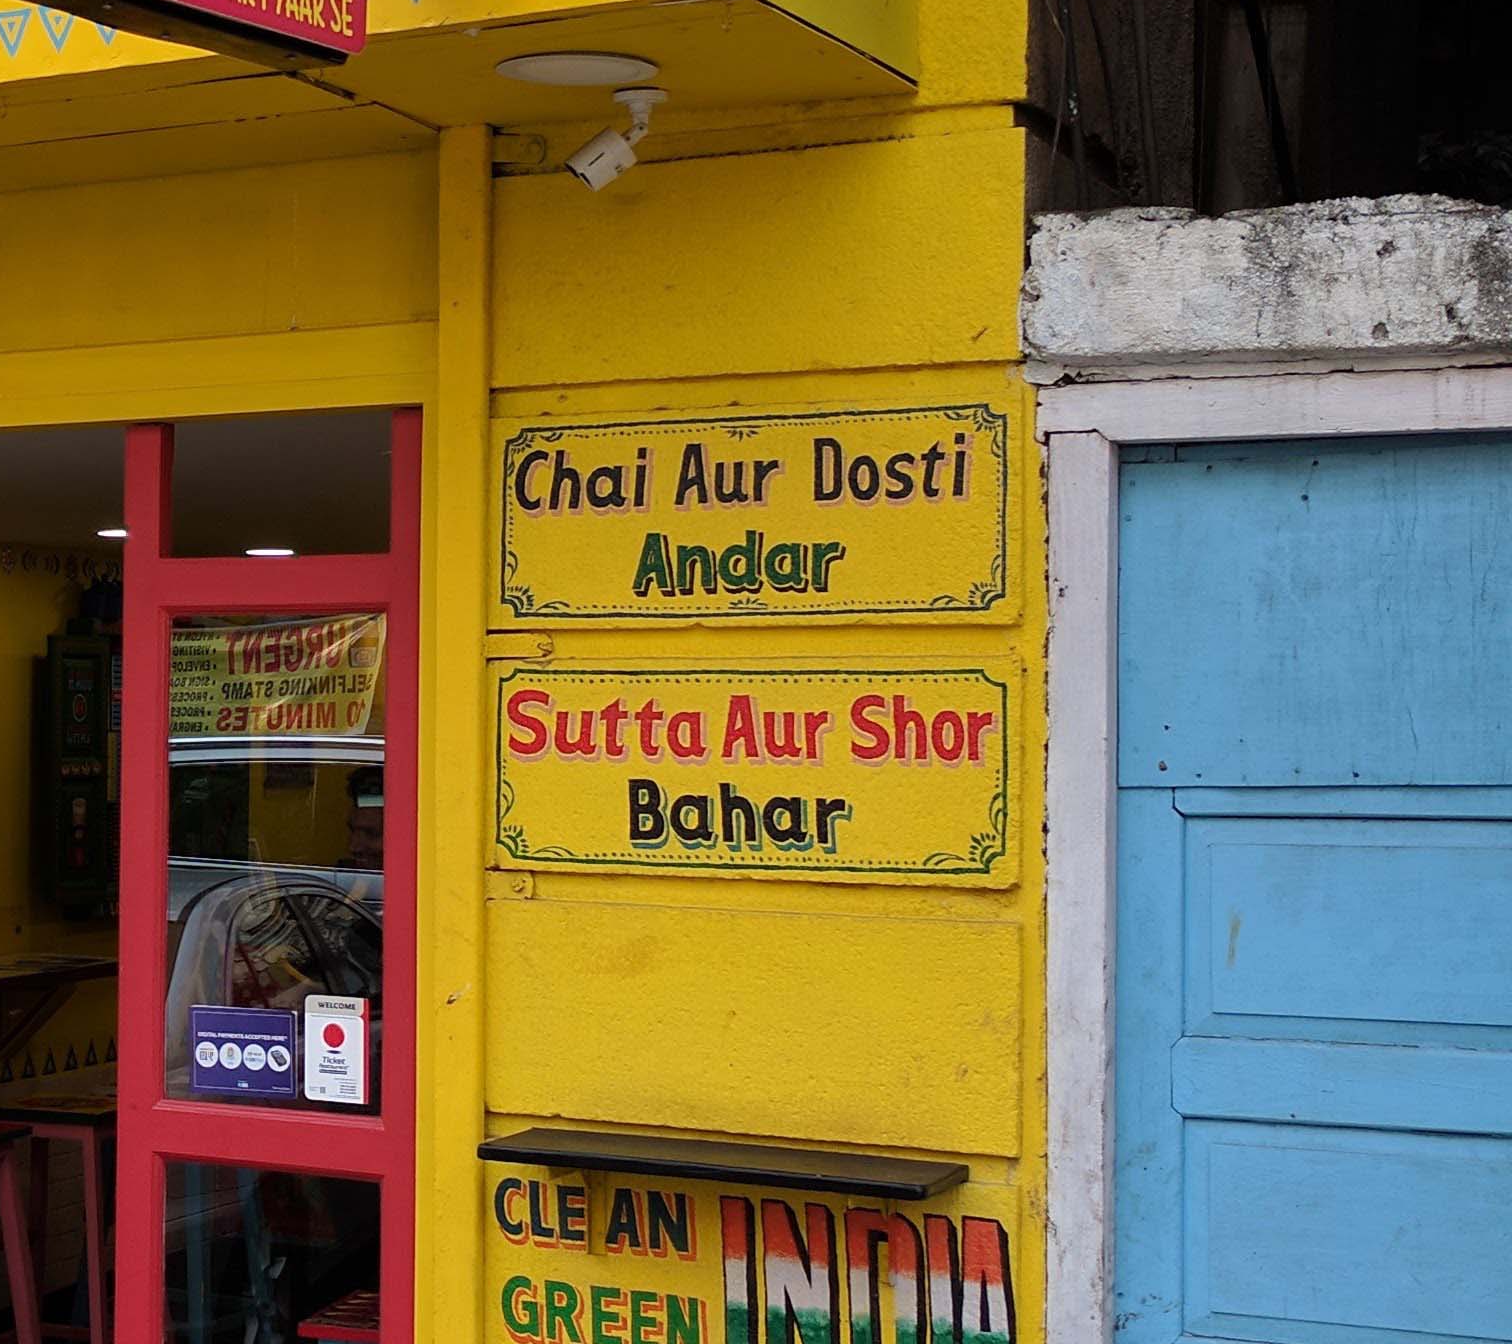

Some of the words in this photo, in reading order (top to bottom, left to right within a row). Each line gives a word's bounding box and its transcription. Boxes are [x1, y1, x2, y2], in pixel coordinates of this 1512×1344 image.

[514, 448, 654, 517] Chai
[674, 443, 785, 511] Aur
[812, 433, 973, 505] Dosti
[632, 530, 845, 598] Andar
[506, 689, 708, 763] Sutta
[720, 695, 834, 763] Aur
[849, 694, 997, 767] Shor
[627, 779, 852, 854] Bahar
[318, 1002, 356, 1010] WELCOME
[322, 1056, 345, 1064] Ticket
